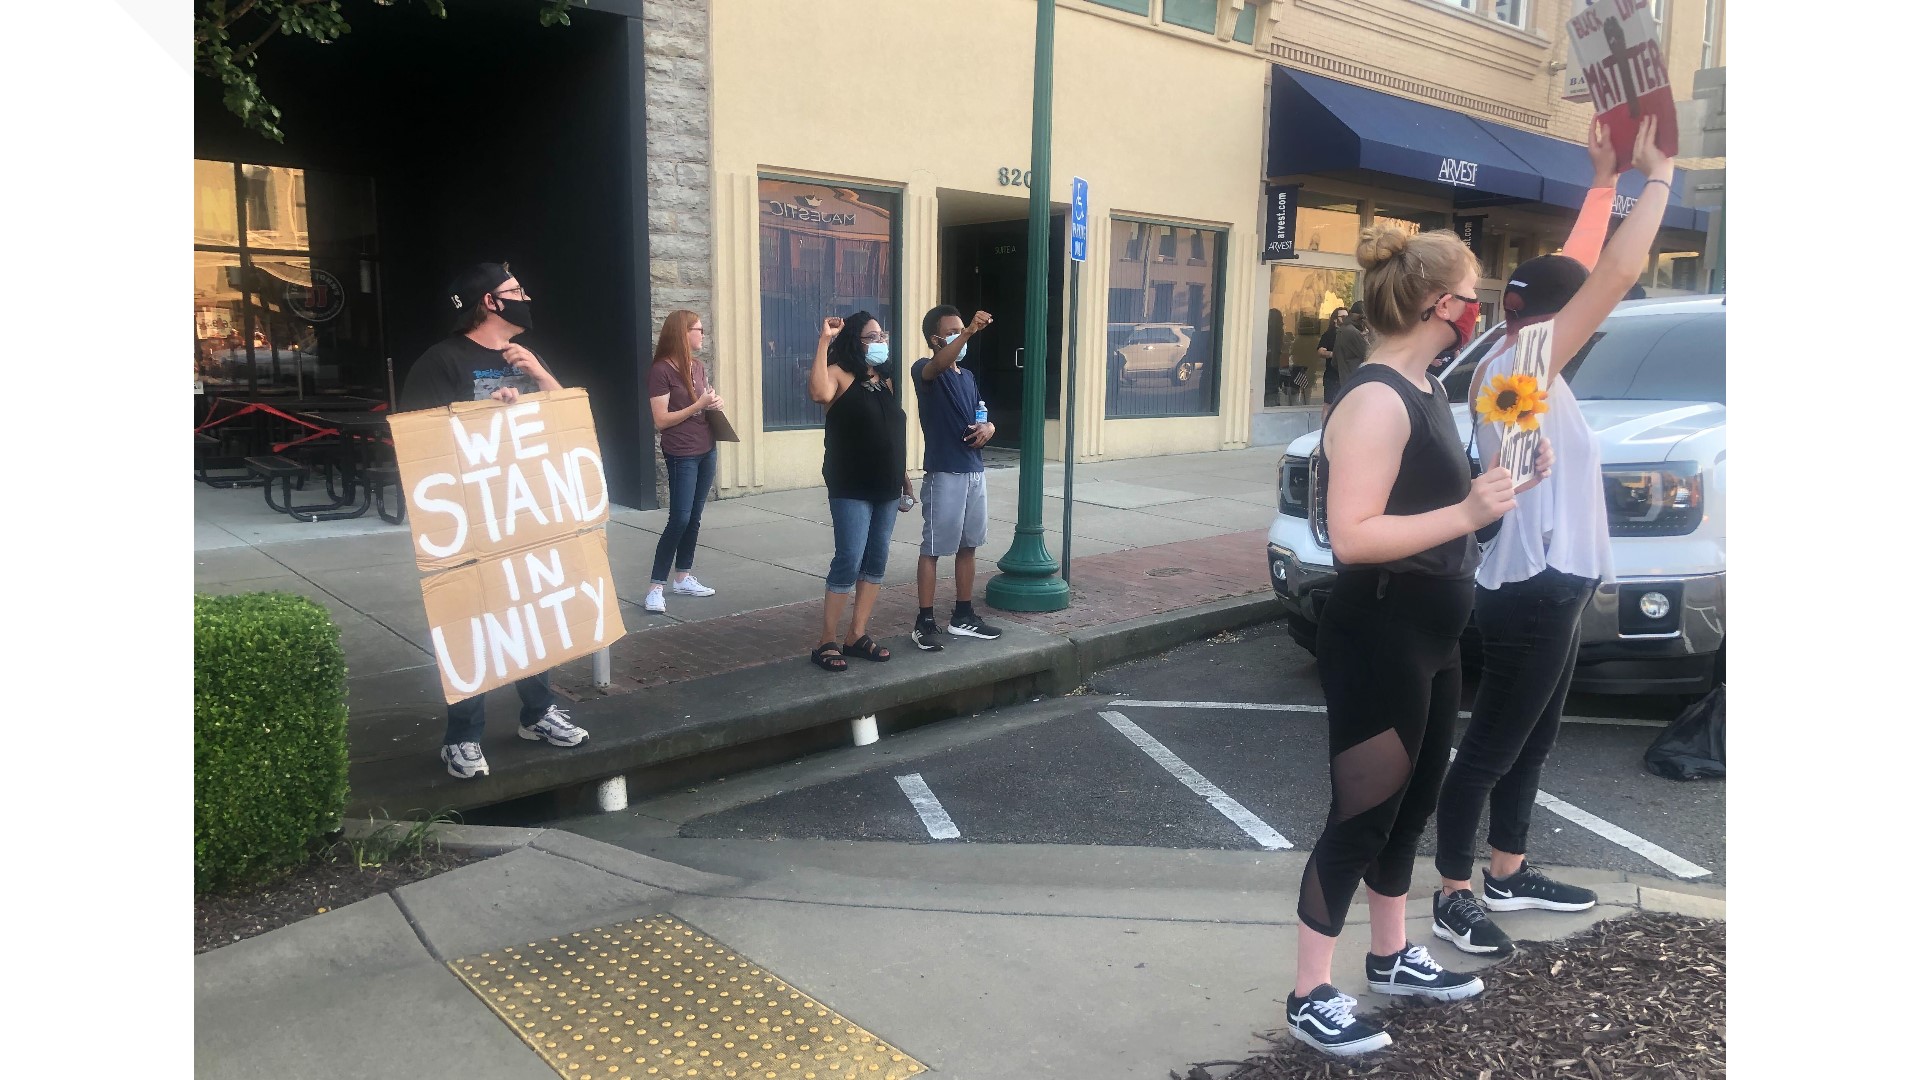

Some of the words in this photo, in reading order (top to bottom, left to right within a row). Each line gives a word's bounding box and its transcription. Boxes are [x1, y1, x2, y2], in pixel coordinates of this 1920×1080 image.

[1582, 38, 1669, 112] MATTER
[998, 167, 1032, 188] 820
[1438, 158, 1477, 186] ARVEST
[1276, 192, 1287, 239] arvest.com
[1268, 240, 1292, 253] ARVEST
[451, 401, 549, 466] WE
[413, 447, 608, 558] STAND
[502, 549, 566, 601] IN
[432, 577, 605, 693] UNITY
